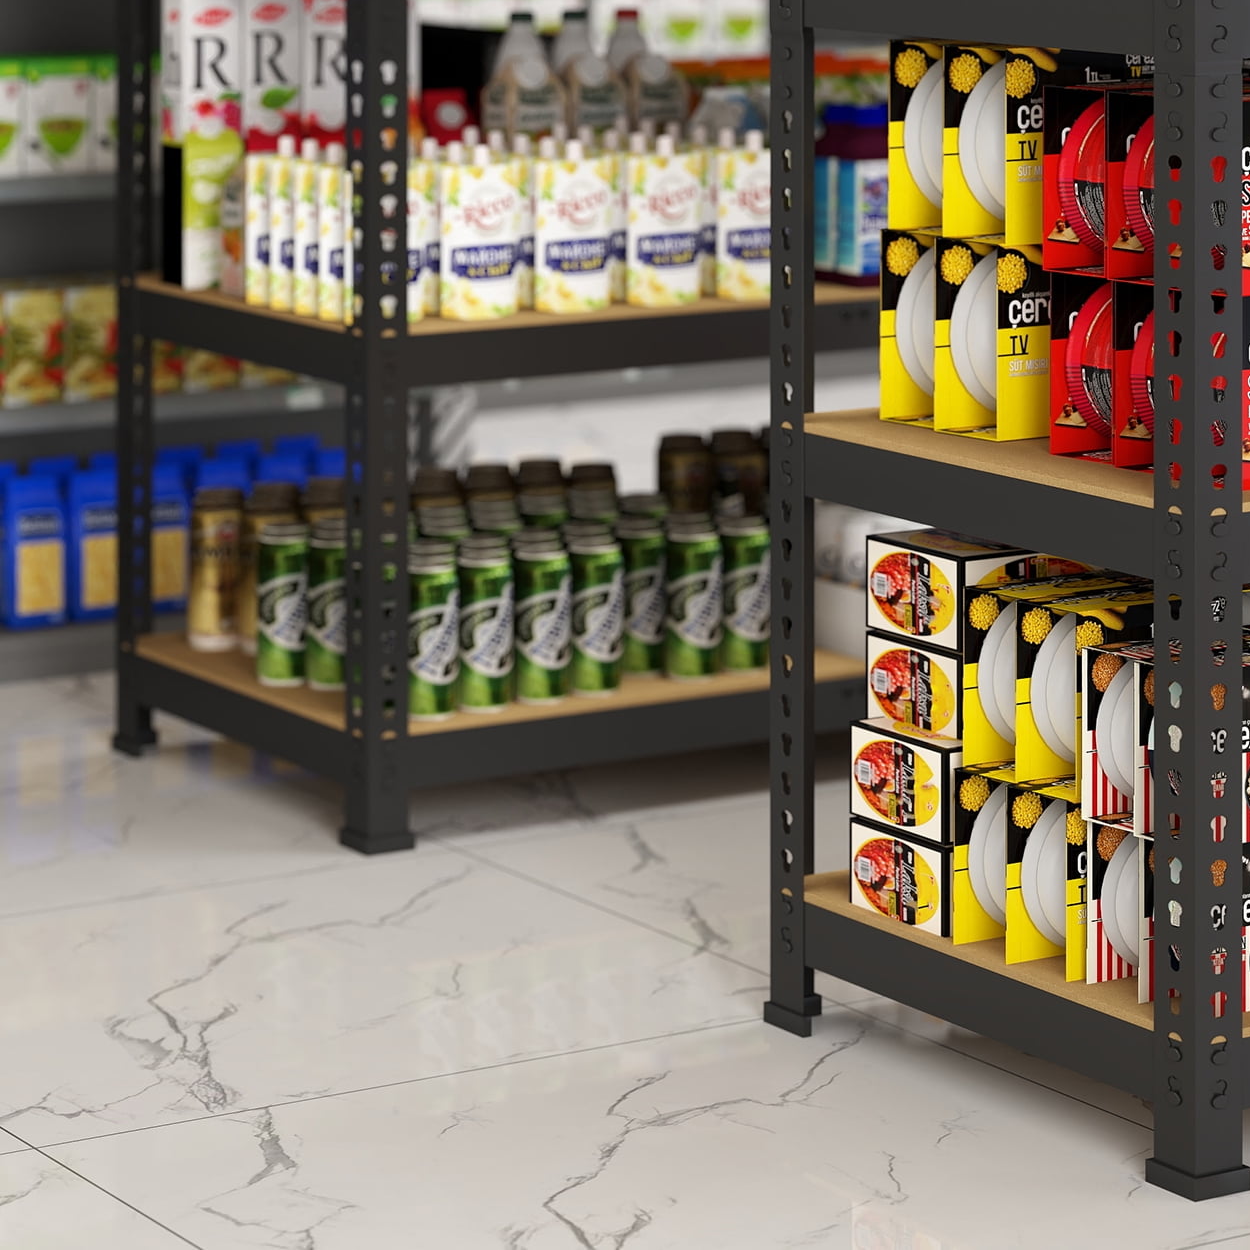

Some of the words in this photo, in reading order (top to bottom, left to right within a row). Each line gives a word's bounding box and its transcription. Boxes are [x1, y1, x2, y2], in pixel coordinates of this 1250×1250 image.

[193, 35, 230, 89] R
[254, 31, 288, 85] R
[1018, 140, 1038, 160] TV
[1010, 334, 1029, 354] TV
